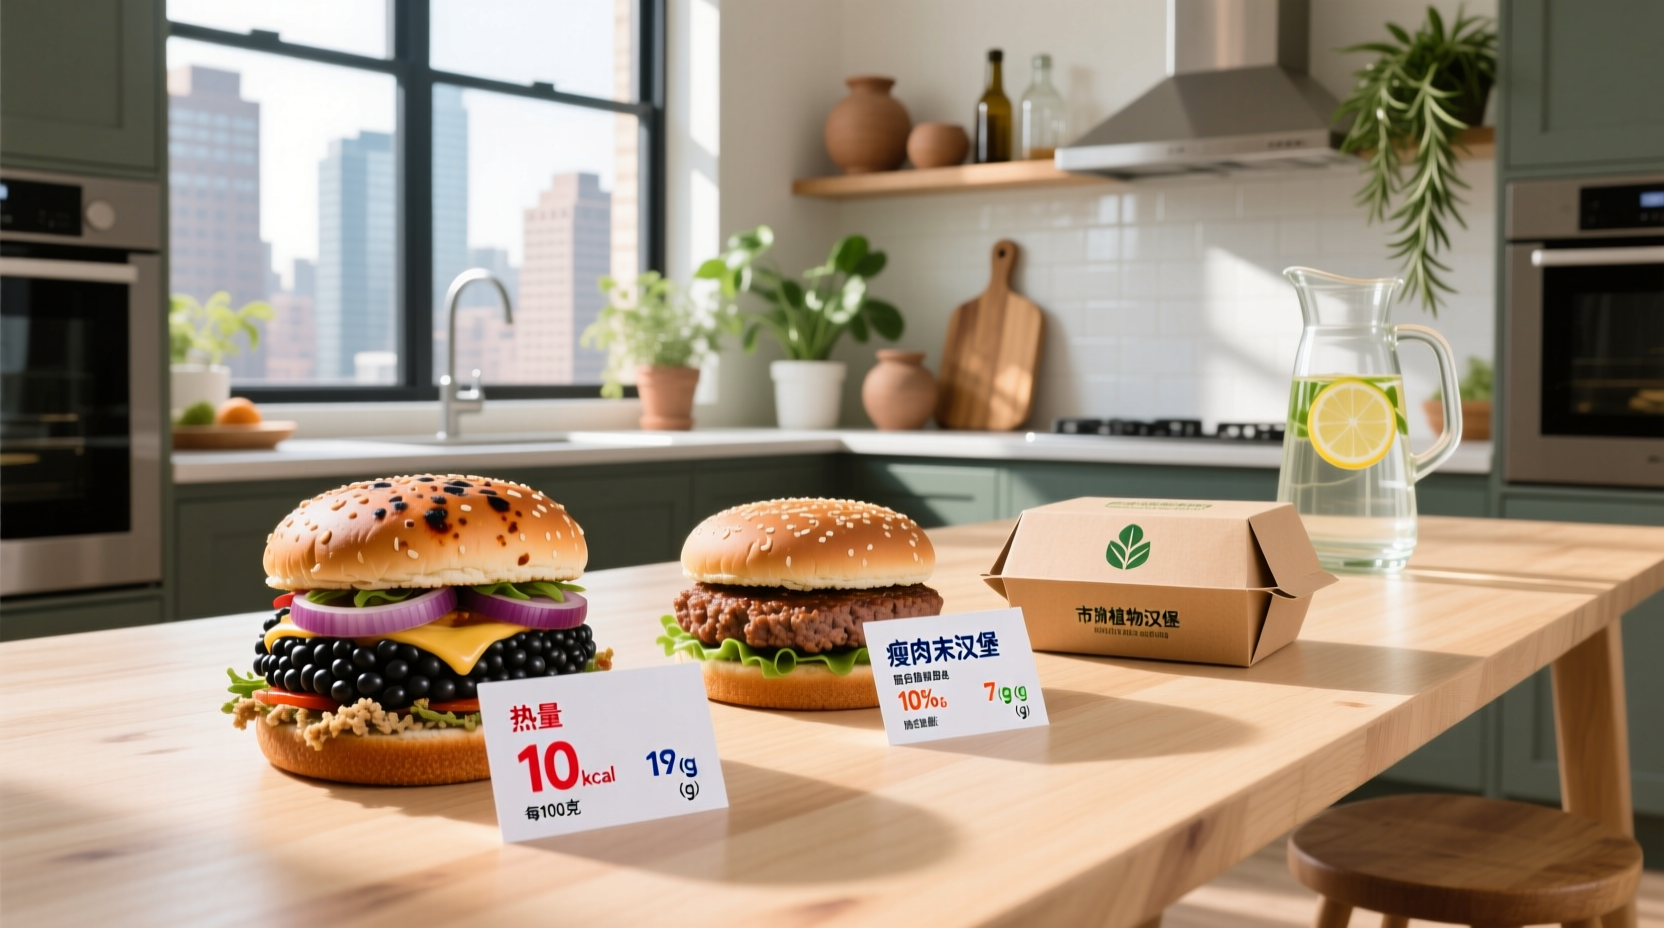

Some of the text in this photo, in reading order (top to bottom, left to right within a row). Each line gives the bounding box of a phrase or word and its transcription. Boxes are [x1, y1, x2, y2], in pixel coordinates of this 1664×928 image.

[886, 631, 1000, 667] 瘦肉末汉堡
[510, 702, 563, 732] 热量
[679, 780, 700, 800] (g)
